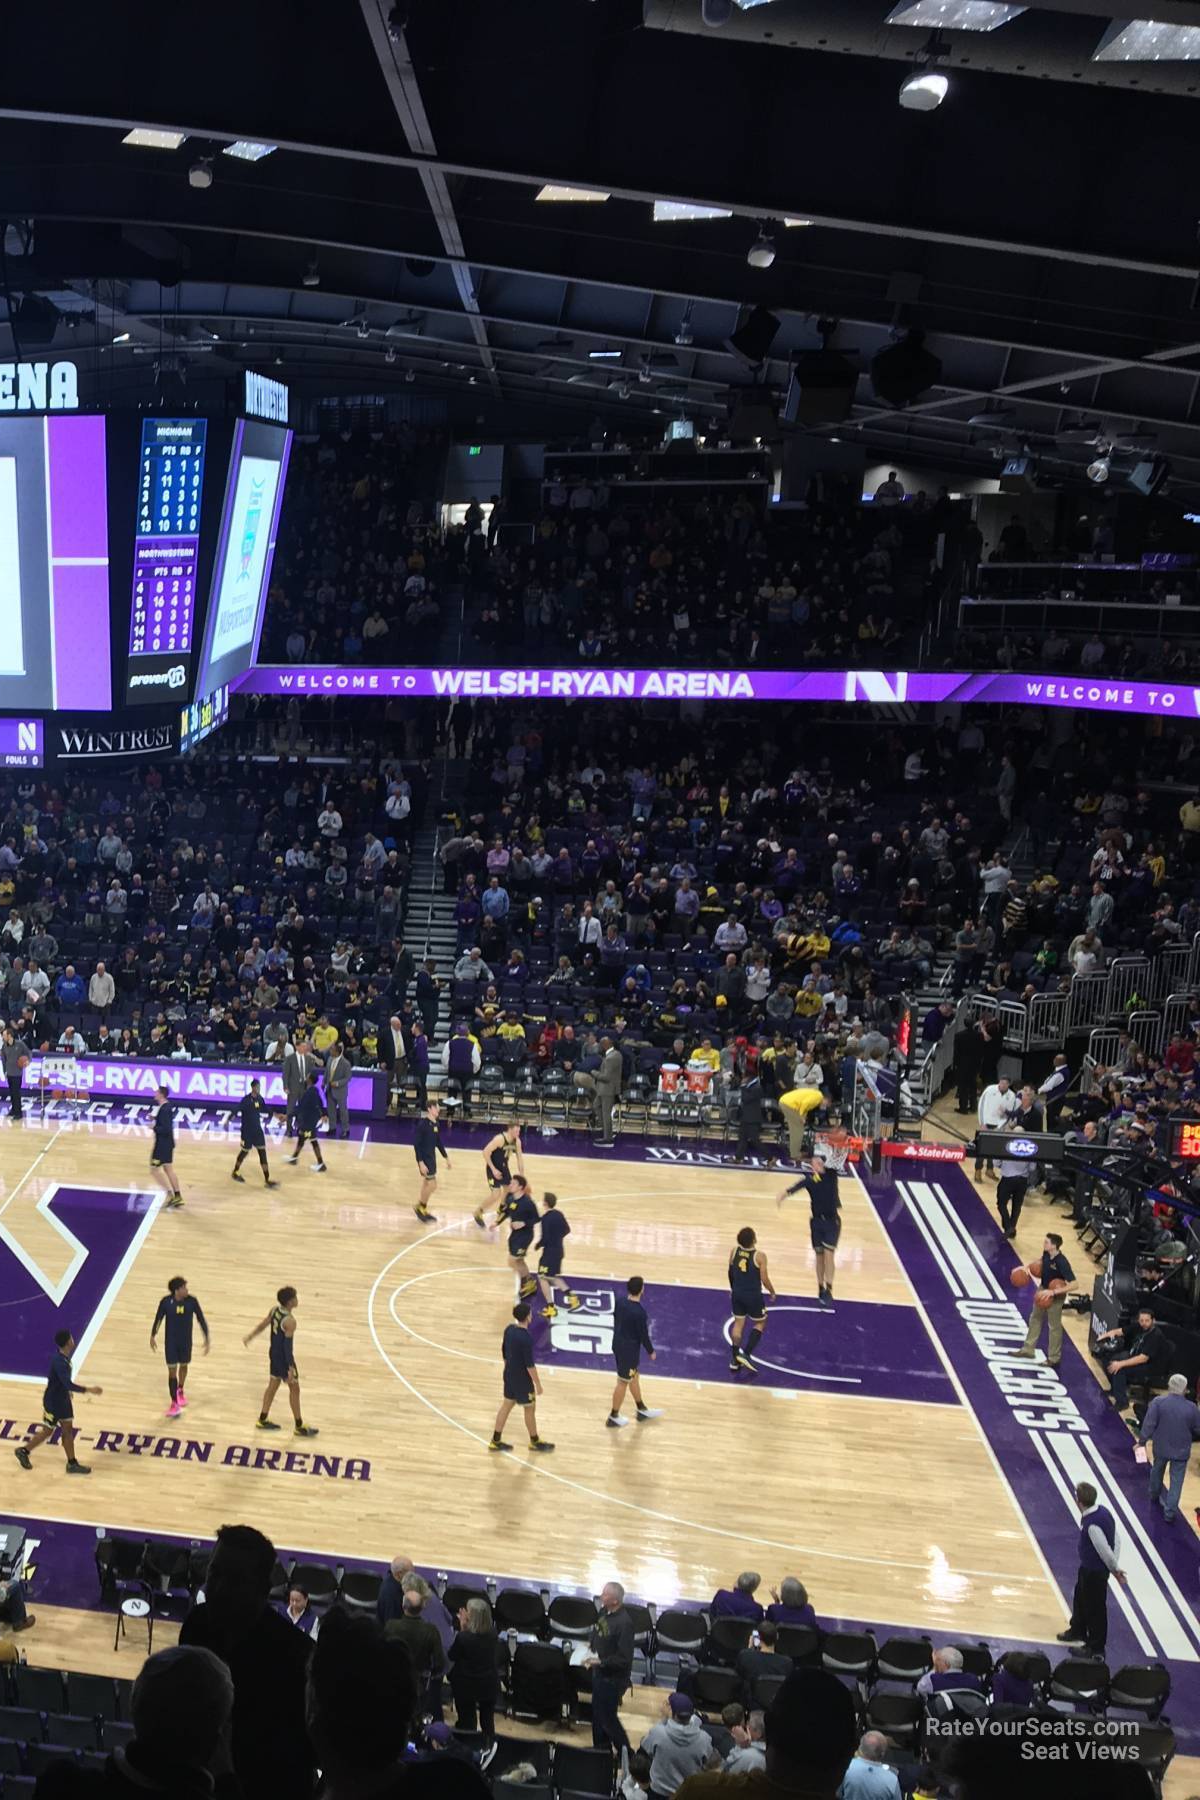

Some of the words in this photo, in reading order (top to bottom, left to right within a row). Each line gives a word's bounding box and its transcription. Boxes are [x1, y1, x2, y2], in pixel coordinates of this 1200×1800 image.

[157, 427, 192, 436] MICHIGAN
[162, 446, 176, 455] PTS
[144, 460, 150, 472] 1
[164, 460, 171, 472] 3
[181, 460, 186, 472] 1
[194, 460, 199, 472] 1
[143, 475, 150, 487] 2
[161, 475, 172, 487] 11
[180, 475, 185, 487] 1
[193, 475, 199, 487] 0
[142, 490, 149, 502] 3
[178, 490, 185, 502] 3
[192, 489, 197, 501] 1
[141, 505, 148, 517] 4
[162, 505, 169, 517] 0
[177, 504, 184, 516] 3
[191, 504, 197, 516] 0
[141, 520, 151, 532] 13
[159, 520, 170, 532] 10
[177, 519, 182, 531] 1
[190, 519, 196, 531] 0
[139, 548, 194, 558] NORTHWESTERN
[155, 567, 168, 576] PTS
[137, 582, 143, 593] 4
[172, 581, 179, 592] 2
[185, 580, 191, 592] 3
[171, 595, 178, 607] 4
[185, 595, 191, 606] 0
[135, 611, 145, 622] 11
[155, 610, 162, 622] 0
[170, 610, 176, 621] 3
[184, 609, 189, 620] 1
[134, 625, 144, 637] 14
[154, 624, 160, 636] 4
[169, 623, 176, 635] 0
[183, 623, 188, 634] 2
[133, 640, 143, 651] 21
[153, 638, 160, 650] 0
[168, 637, 175, 649] 2
[182, 637, 187, 648] 0
[278, 674, 380, 689] WELCOME
[392, 675, 418, 689] TO
[432, 670, 636, 697] WELSH-RYAN
[641, 672, 755, 697] ARENA
[844, 671, 908, 703] N
[1026, 681, 1135, 705] WELCOME
[1148, 691, 1176, 708] TO
[18, 722, 36, 751] N
[59, 725, 173, 753] WINTRUST
[6, 756, 27, 765] FOULS
[32, 756, 38, 766] 0
[124, 1103, 206, 1122] TN
[917, 1147, 965, 1161] StateFarm
[221, 1445, 372, 1482] ARENA
